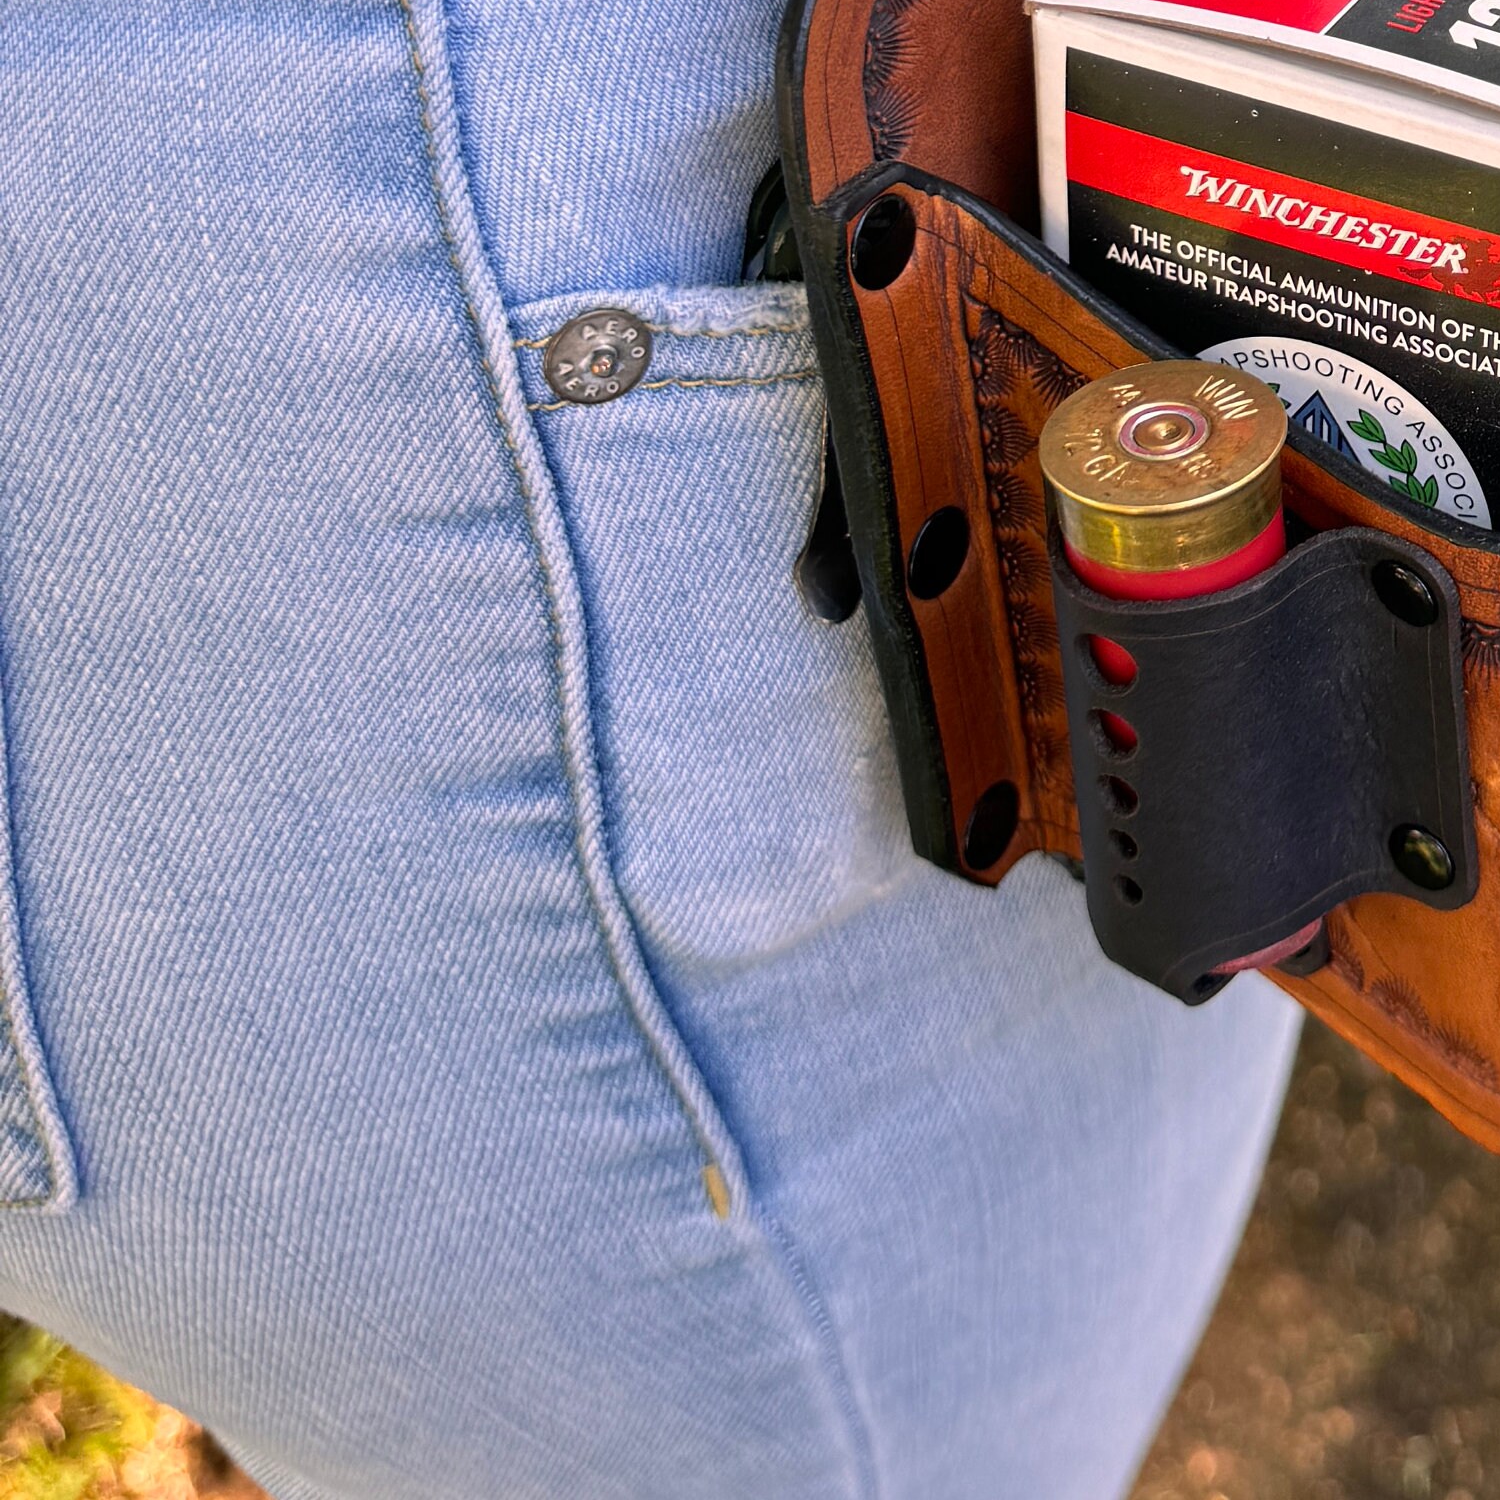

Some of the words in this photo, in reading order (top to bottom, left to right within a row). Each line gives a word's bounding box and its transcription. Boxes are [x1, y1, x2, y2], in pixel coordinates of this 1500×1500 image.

[1180, 165, 1467, 274] WINCHESTER
[1106, 243, 1209, 291] AMATEUR
[1212, 275, 1388, 345] TRAPSHOOTING
[1130, 224, 1172, 254] THE
[1177, 240, 1277, 287] OFFICIAL
[1280, 272, 1435, 333] AMMUNITION
[1441, 319, 1477, 343] OF
[581, 319, 646, 358] AERO
[557, 361, 620, 398] AERO
[1194, 374, 1260, 420] WIN
